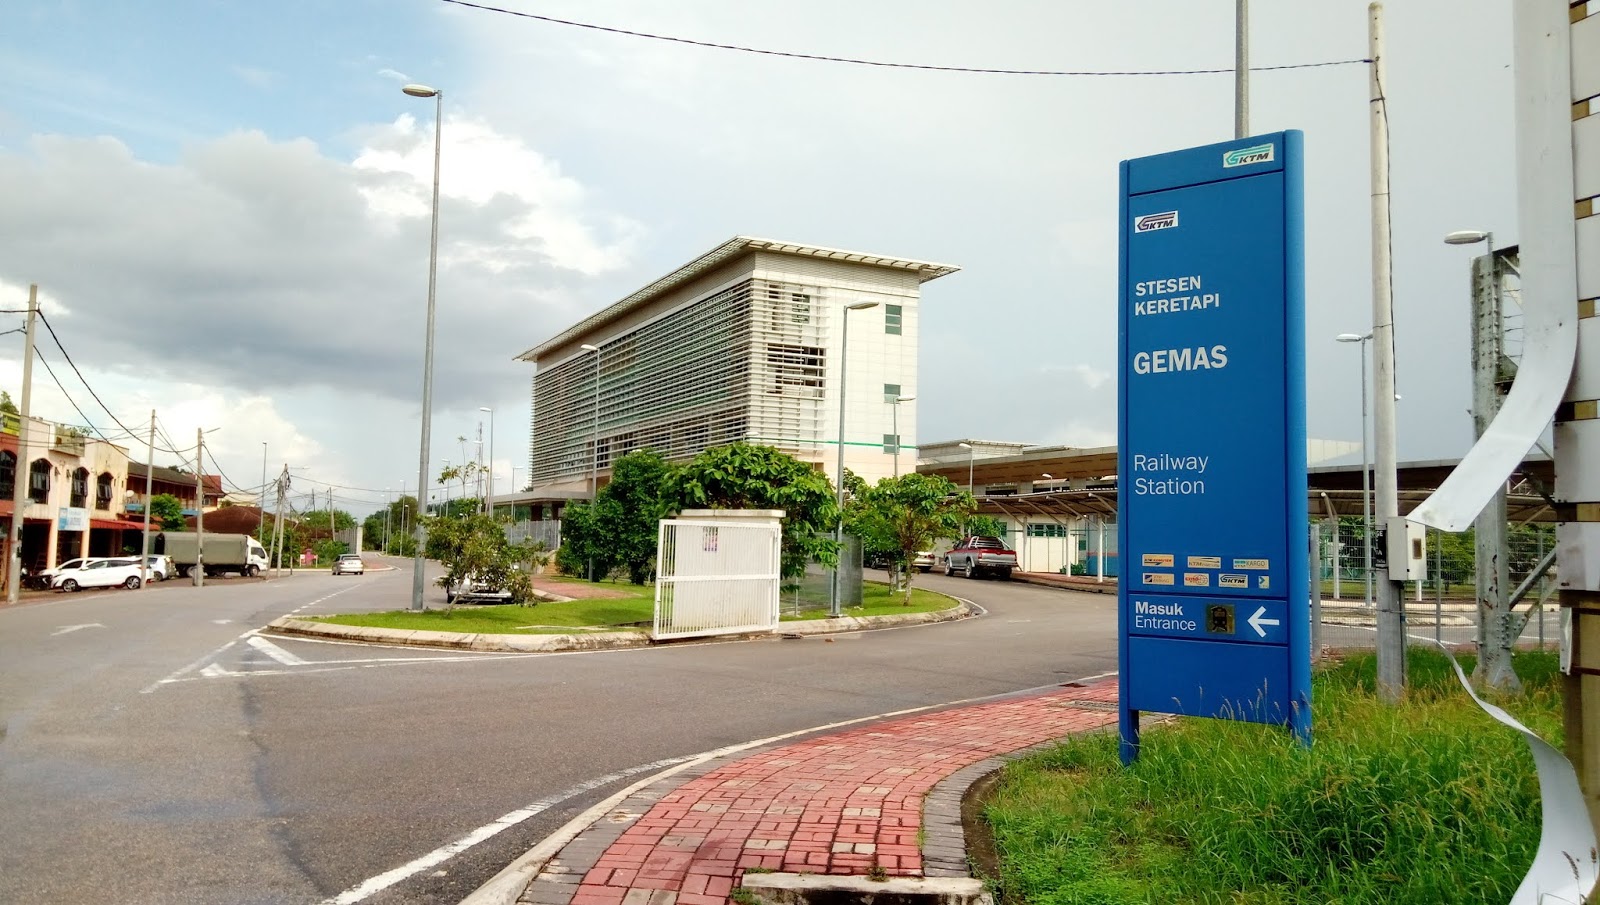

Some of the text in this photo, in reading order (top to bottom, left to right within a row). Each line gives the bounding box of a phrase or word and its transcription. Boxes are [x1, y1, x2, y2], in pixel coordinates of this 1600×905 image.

[1135, 275, 1201, 297] STESEN
[1135, 293, 1220, 316] KERETAPI
[1133, 345, 1228, 375] GEMAS
[1134, 453, 1209, 474] Railway
[1134, 477, 1205, 495] Station
[1135, 601, 1184, 616] Masuk
[1135, 616, 1197, 631] Entrance
